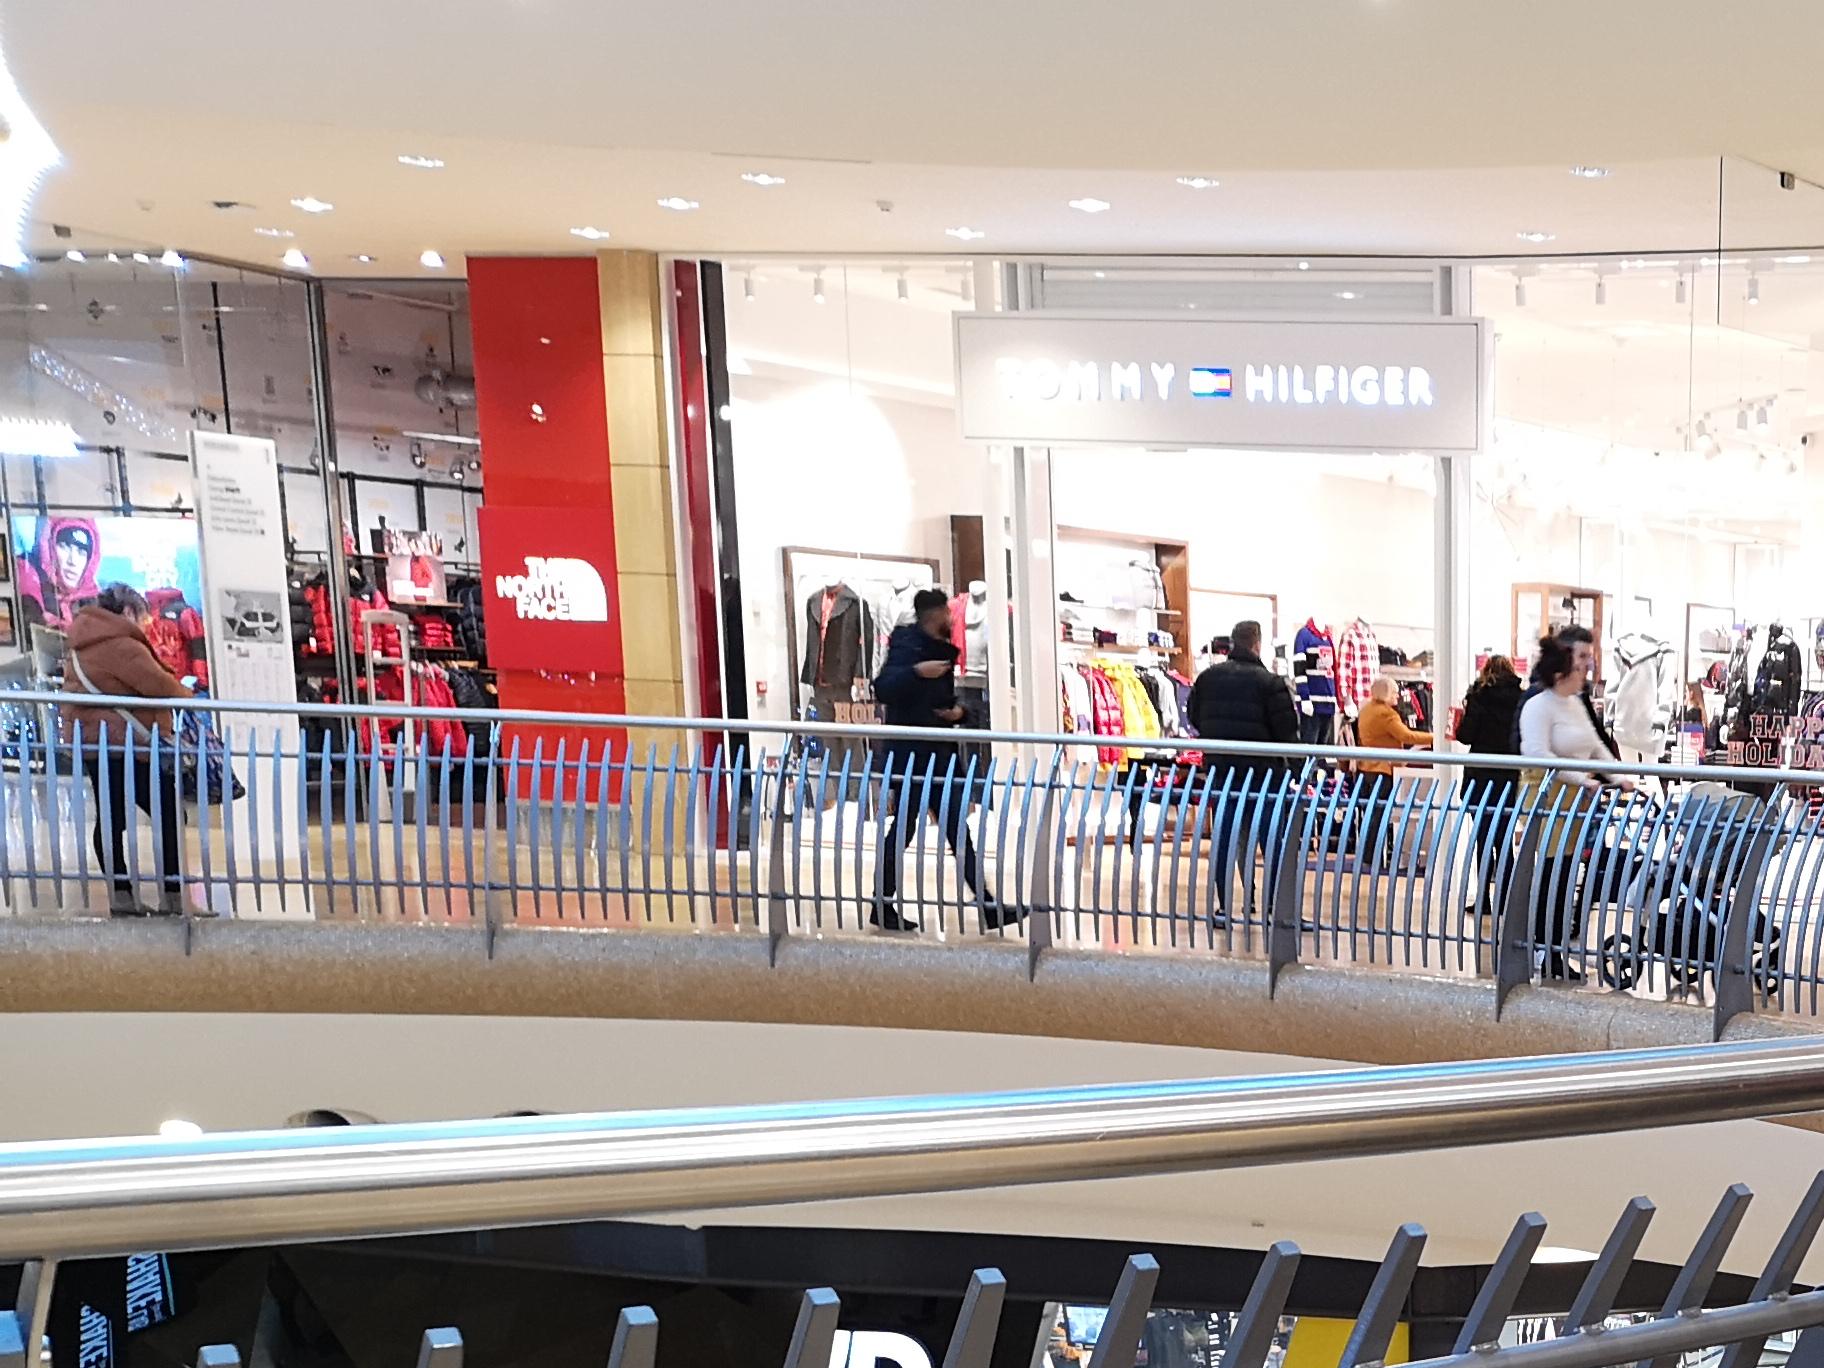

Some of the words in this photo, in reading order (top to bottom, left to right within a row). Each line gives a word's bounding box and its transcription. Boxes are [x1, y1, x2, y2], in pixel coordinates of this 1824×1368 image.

[996, 357, 1176, 403] TOMMY
[1245, 362, 1434, 406] HILFIGER
[496, 575, 567, 599] NORTH
[515, 598, 570, 621] FACE
